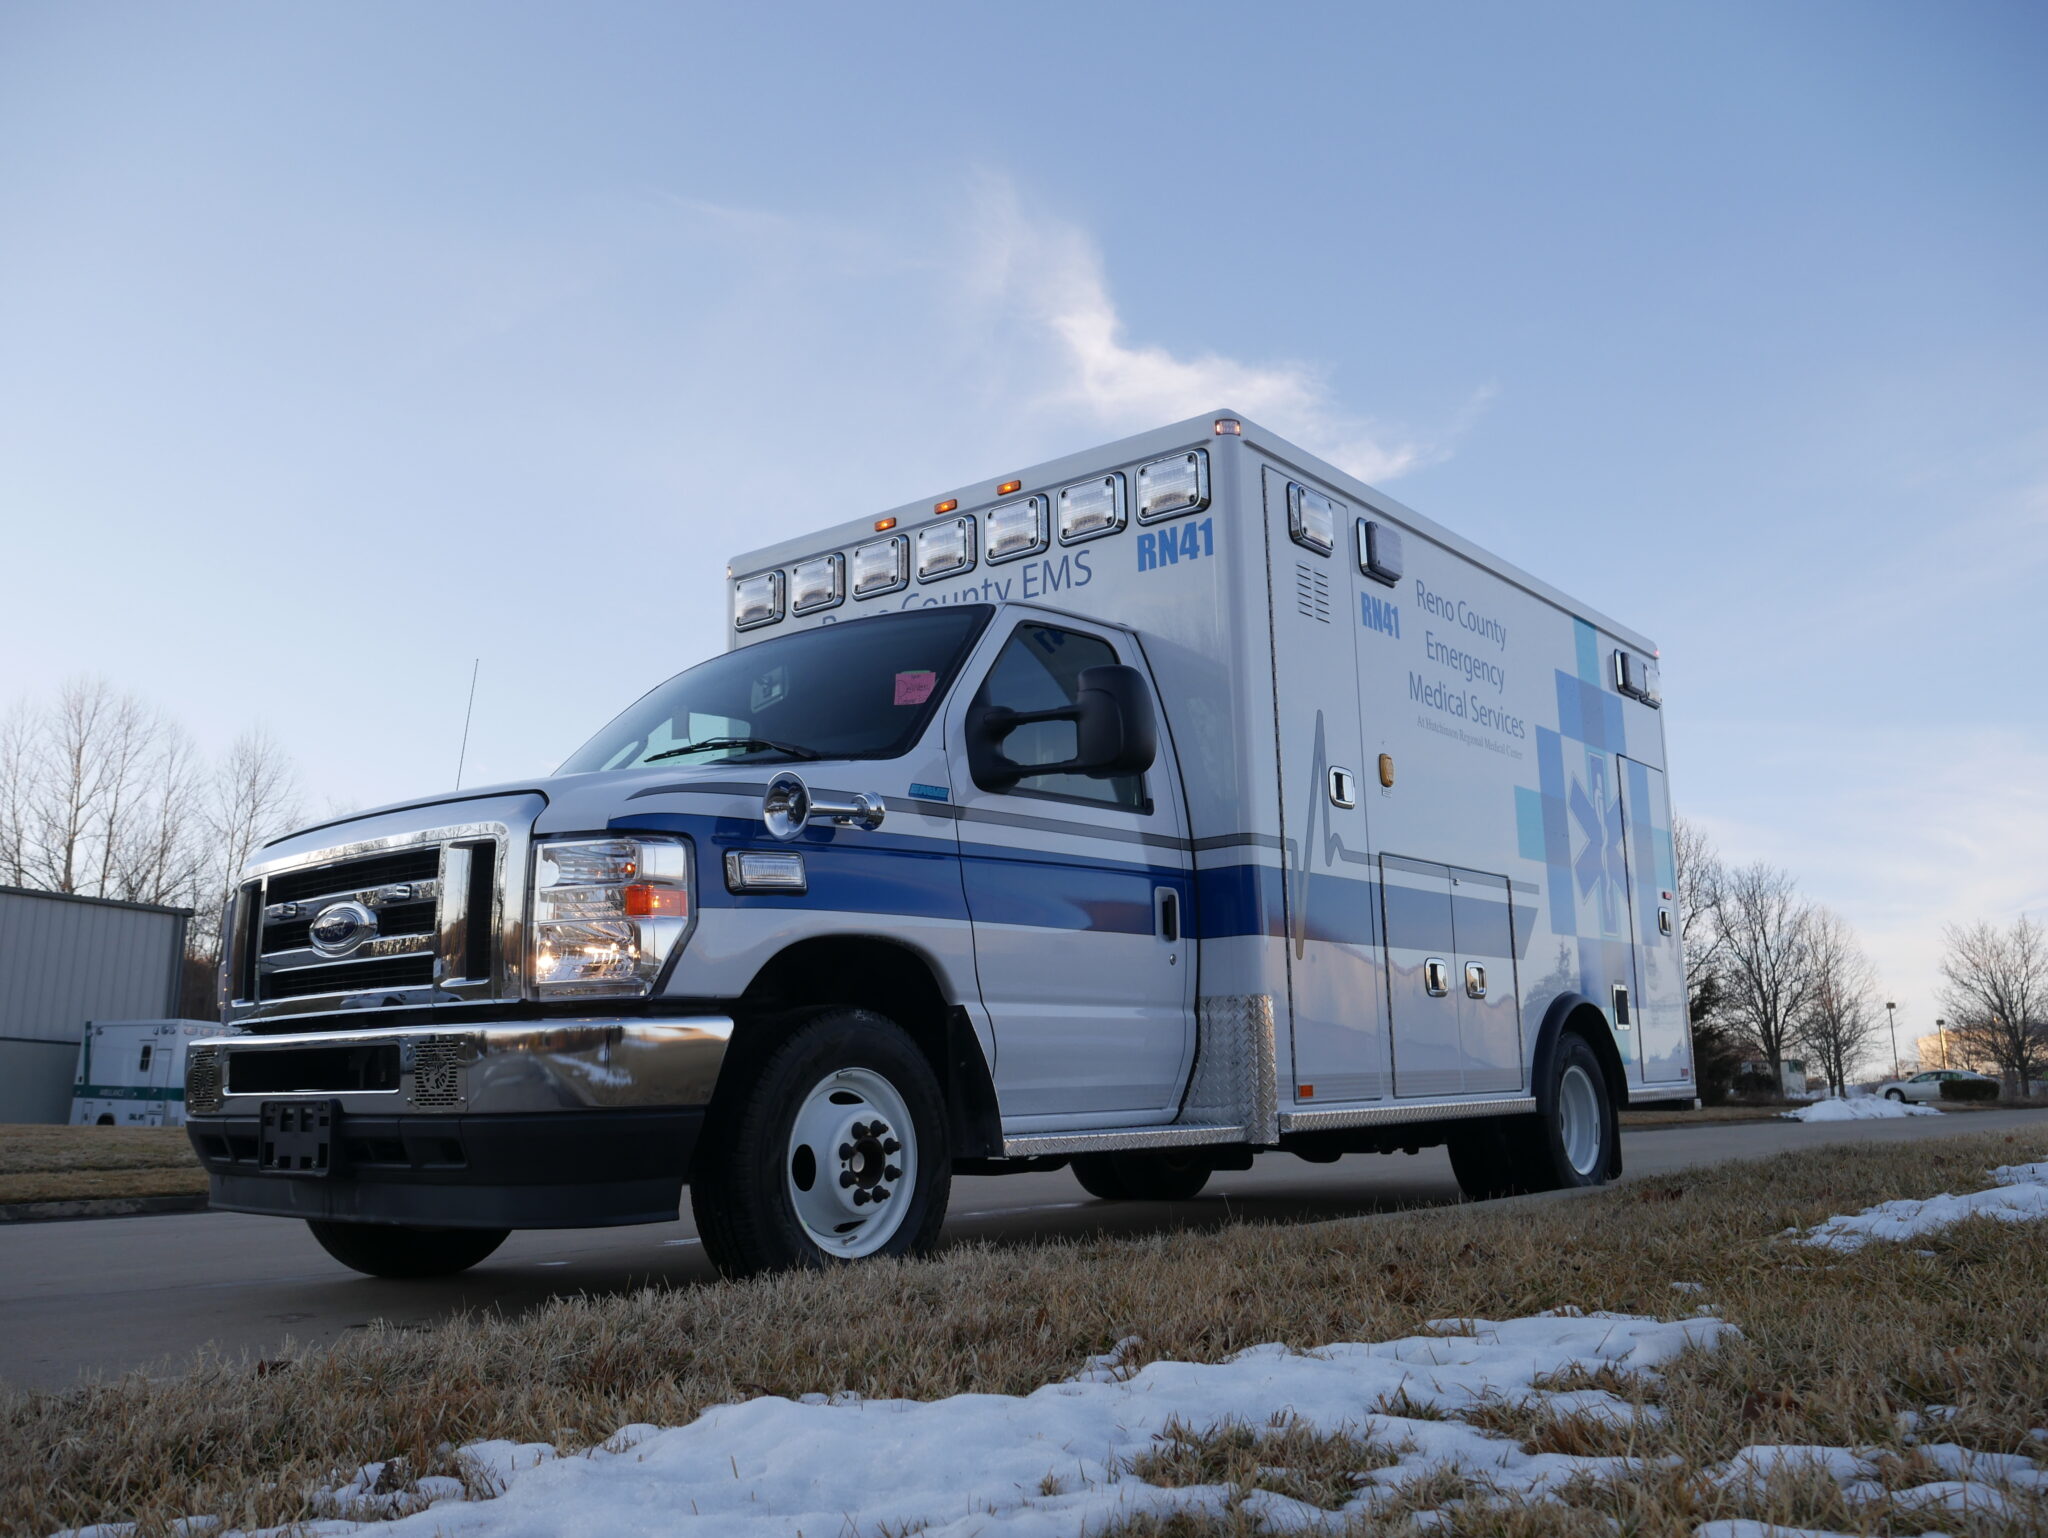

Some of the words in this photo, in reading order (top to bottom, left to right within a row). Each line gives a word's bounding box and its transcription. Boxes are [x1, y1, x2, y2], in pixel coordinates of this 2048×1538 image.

[1136, 517, 1214, 572] RN41
[1022, 549, 1093, 599] EMS
[1360, 591, 1400, 640] RN41
[1416, 579, 1455, 622] Reno
[1457, 600, 1507, 652] County
[1425, 630, 1505, 694] Emergency
[1409, 670, 1468, 720] Medical
[1470, 695, 1526, 740] Services
[318, 916, 348, 938] Ford
